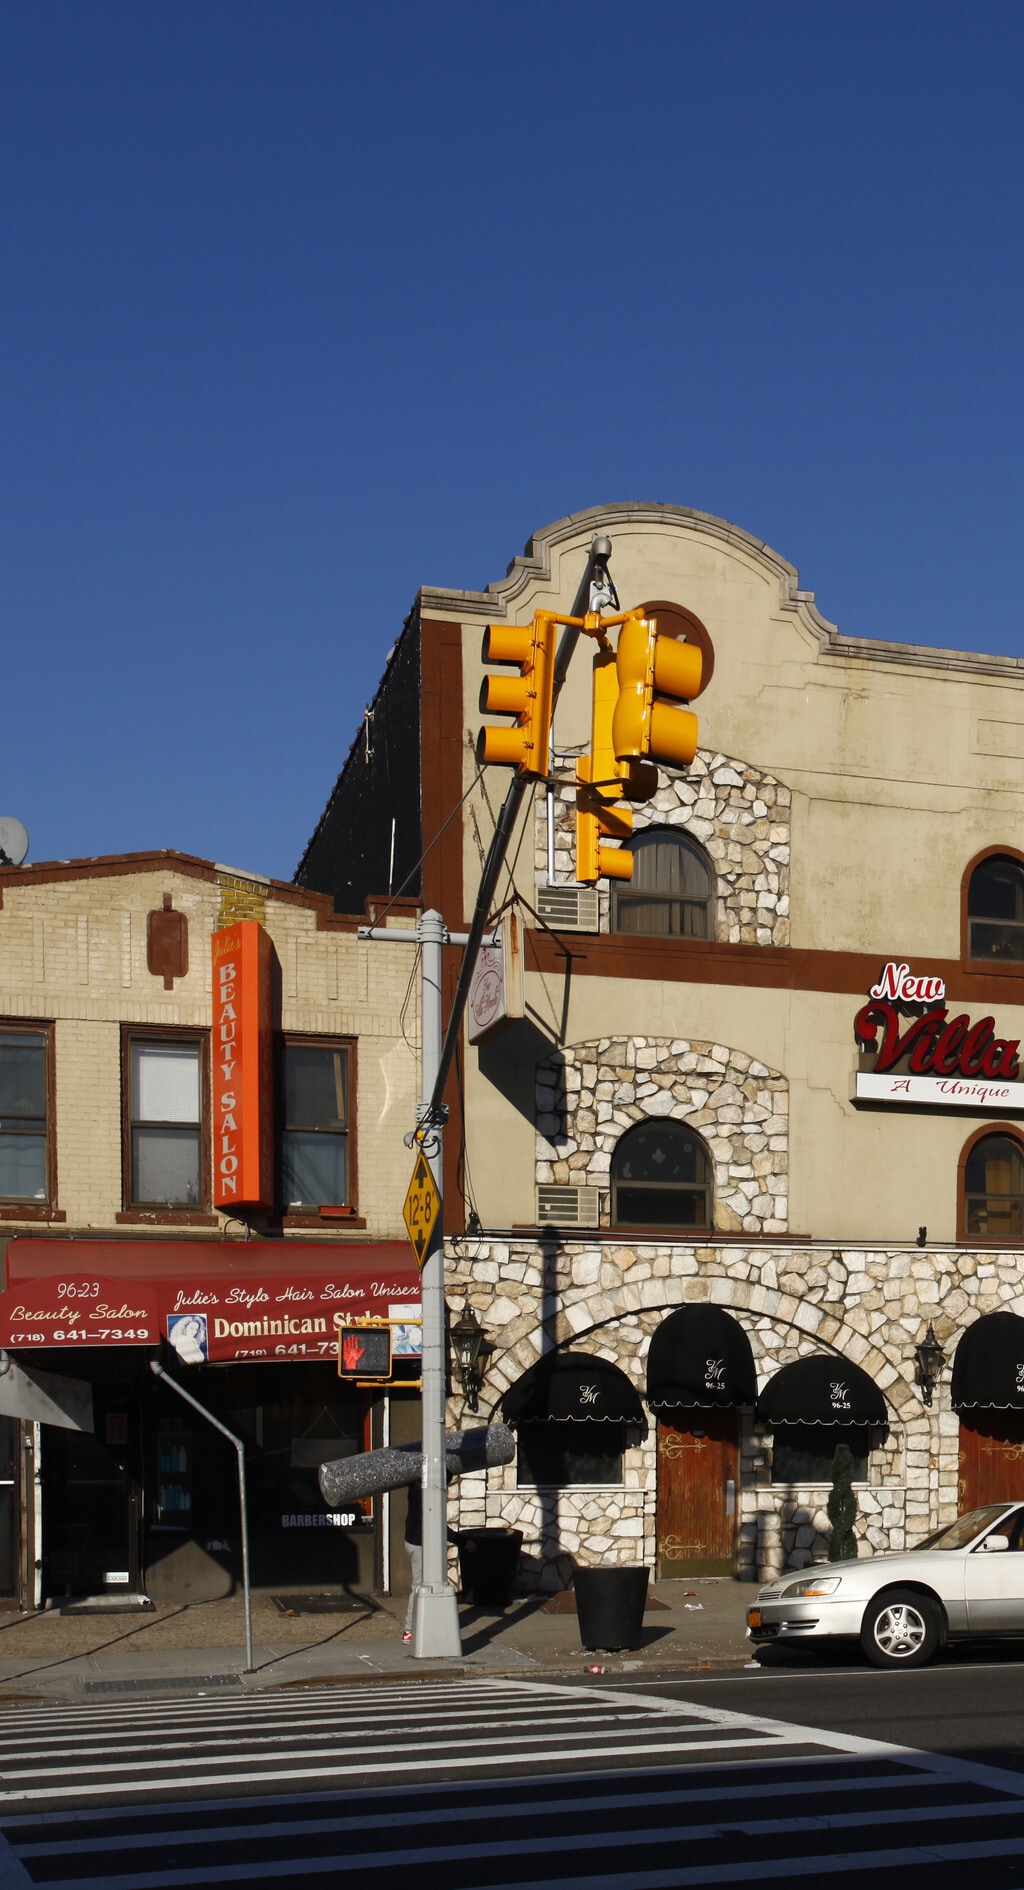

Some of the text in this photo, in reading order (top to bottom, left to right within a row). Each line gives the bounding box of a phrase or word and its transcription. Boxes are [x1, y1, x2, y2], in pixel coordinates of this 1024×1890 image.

[212, 934, 242, 967] Julie's
[872, 962, 944, 1000] New
[856, 1002, 1021, 1079] Villa
[218, 961, 239, 1196] BEAUTY SALON
[890, 1079, 911, 1093] A
[936, 1079, 1010, 1103] Unique
[57, 1282, 100, 1299] 96-23
[173, 1289, 220, 1311] Julie's
[276, 1285, 315, 1301] Hair
[320, 1283, 366, 1299] Salon
[370, 1282, 420, 1297] Unisex
[9, 1303, 148, 1325] Beauty Salon
[10, 1328, 149, 1343] (718) 641-7349
[213, 1313, 327, 1339] Dominican
[274, 1341, 340, 1356] 641-73
[705, 1381, 726, 1391] 96-25
[831, 1401, 851, 1409] 96-25
[281, 1513, 356, 1528] BARBERSHOP
